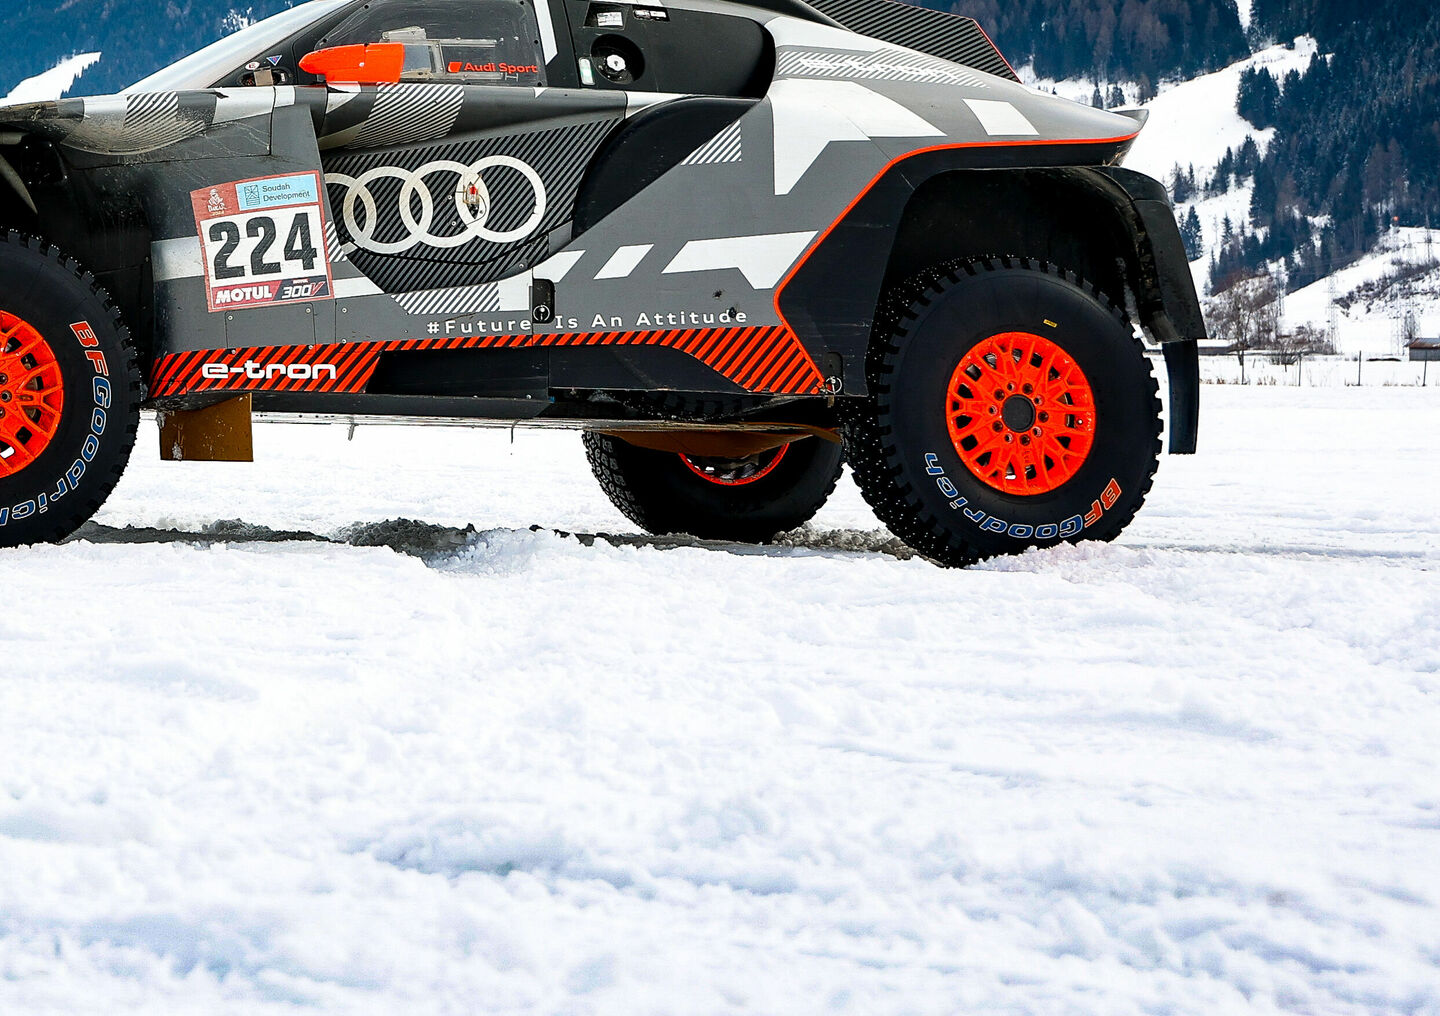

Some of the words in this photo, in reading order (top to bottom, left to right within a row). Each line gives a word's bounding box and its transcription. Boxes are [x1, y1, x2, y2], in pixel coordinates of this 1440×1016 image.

[464, 63, 496, 72] Audi
[498, 62, 538, 73] Sport
[262, 184, 291, 193] Soudah
[262, 190, 310, 202] Development
[208, 212, 317, 280] 224
[215, 285, 272, 304] MOTUL
[281, 281, 325, 299] 300V
[427, 317, 531, 334] #Future
[555, 315, 578, 329] Is
[591, 313, 622, 328] An
[635, 309, 747, 327] Attitude
[202, 359, 336, 379] e-tron
[924, 452, 1122, 538] BFGoodrich
